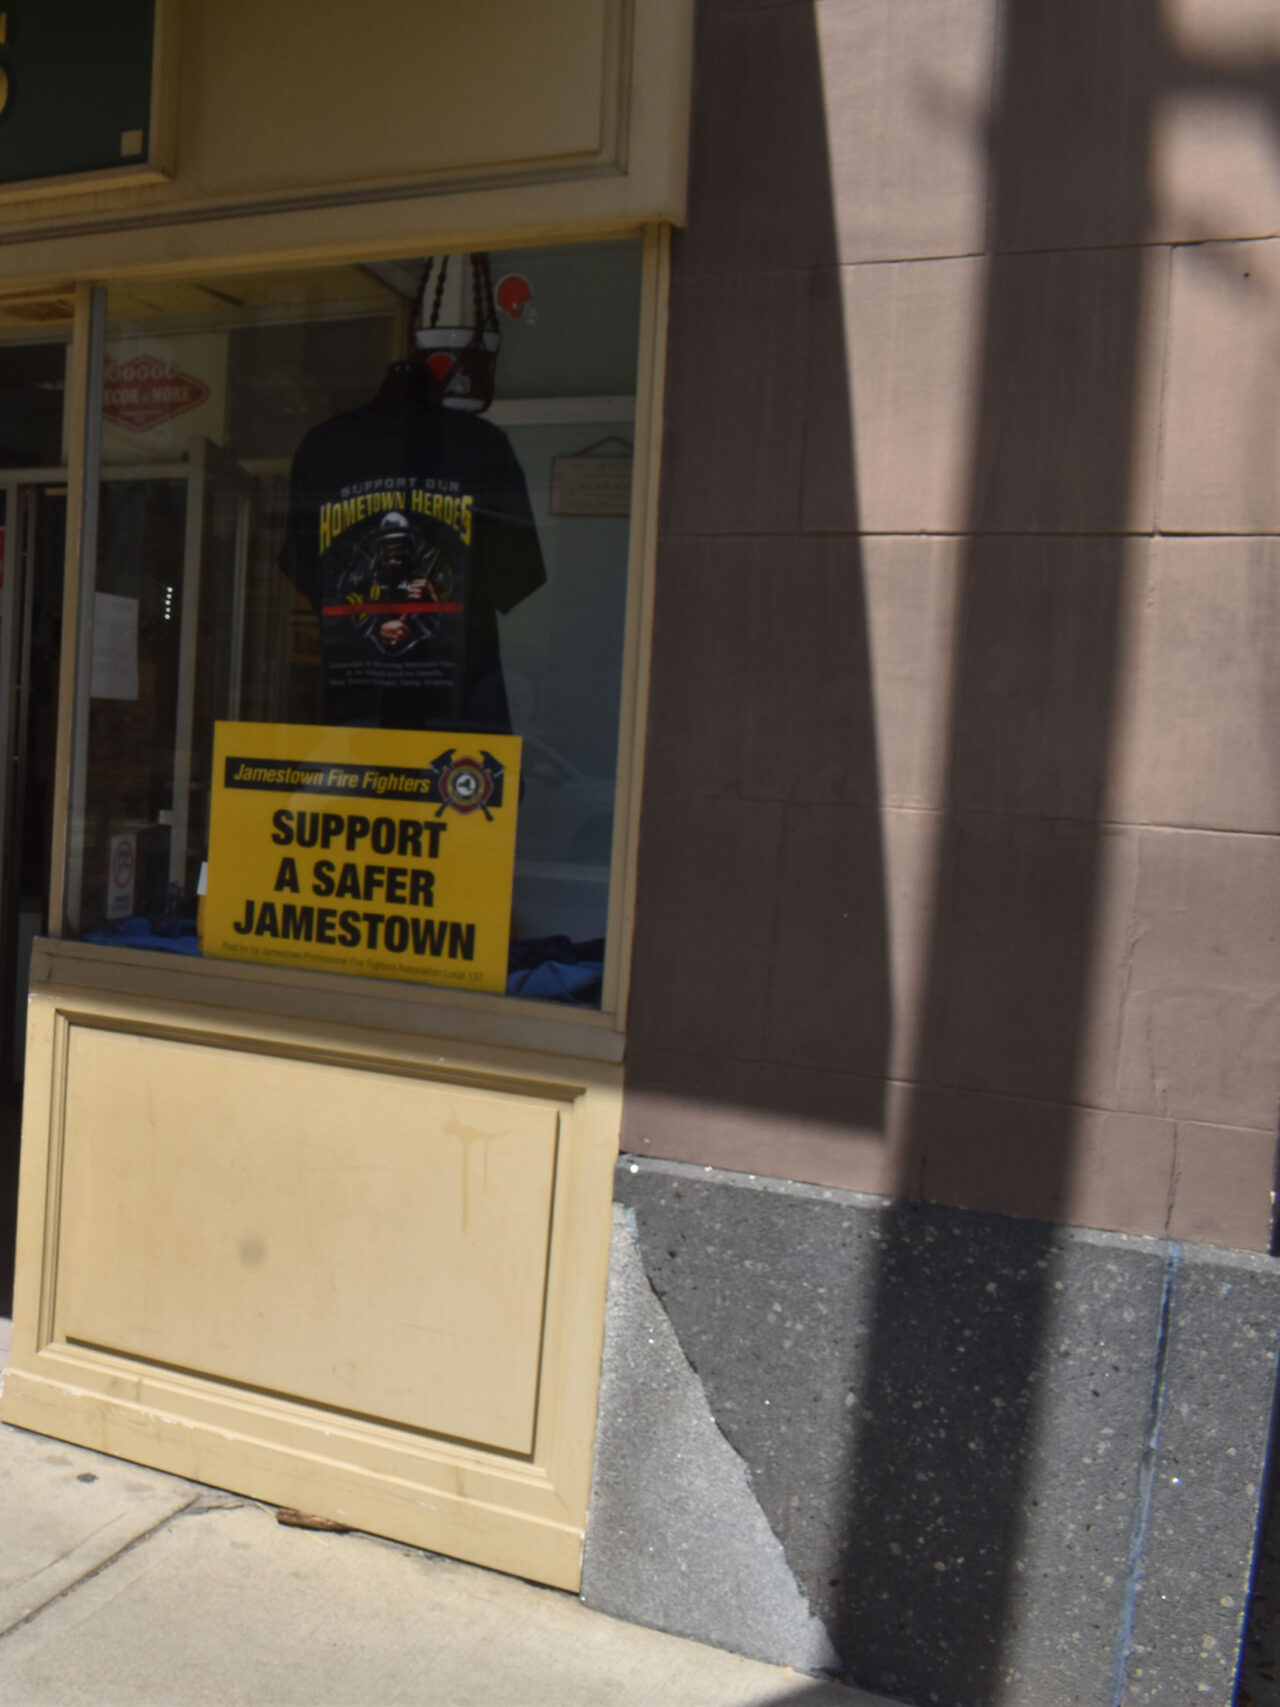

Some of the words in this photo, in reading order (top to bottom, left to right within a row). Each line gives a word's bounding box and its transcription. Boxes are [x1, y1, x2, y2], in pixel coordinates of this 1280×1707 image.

[340, 477, 418, 498] SUPPORT
[424, 478, 460, 493] OUR
[320, 491, 406, 554] HOMETOWN
[411, 489, 474, 546] HEROES
[234, 763, 323, 787] Jamestown
[326, 768, 360, 789] Fire
[362, 770, 431, 794] Fighters
[271, 809, 447, 858] SUPPORT
[274, 857, 299, 894] A
[312, 860, 435, 907] SAFER
[233, 900, 475, 961] JAMESTOWN
